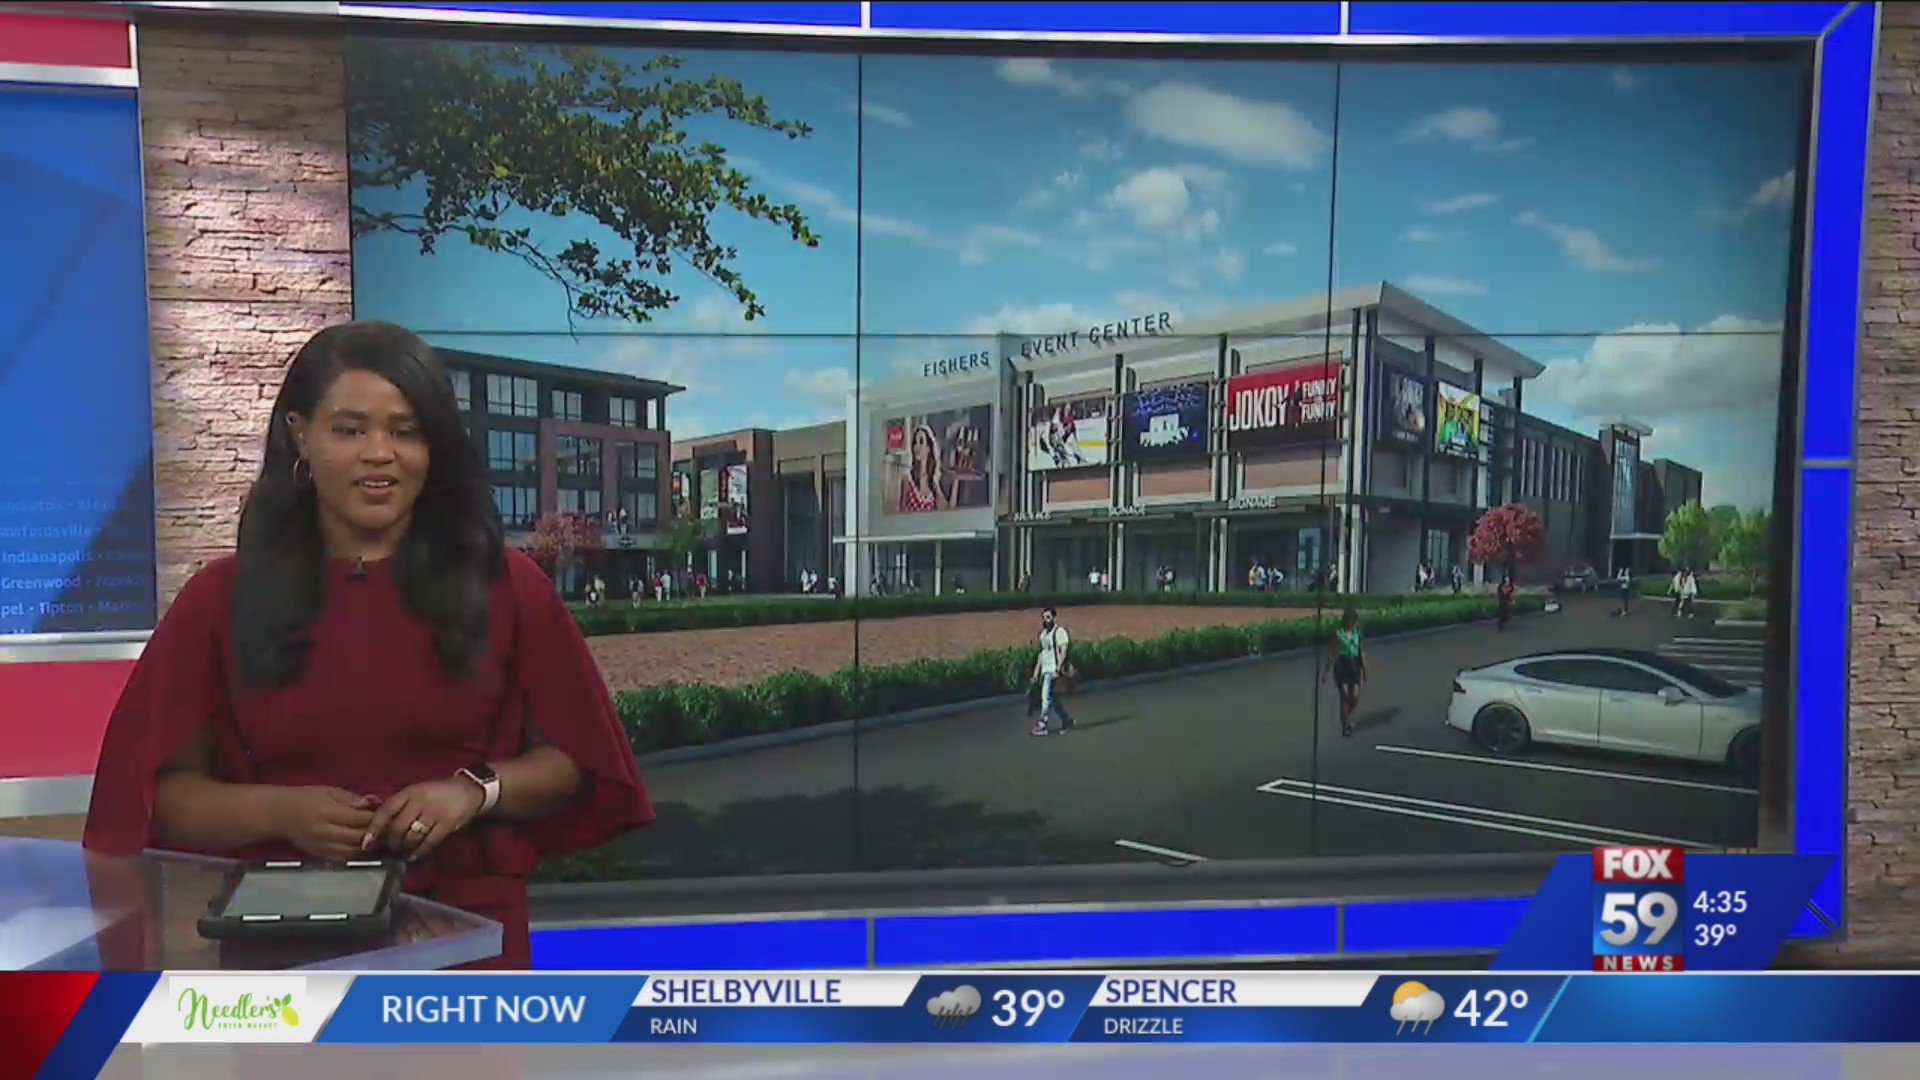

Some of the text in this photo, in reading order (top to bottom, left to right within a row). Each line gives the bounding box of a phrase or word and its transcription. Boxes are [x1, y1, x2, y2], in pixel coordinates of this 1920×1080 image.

[923, 311, 1172, 377] FISHERS EVENT CENTER
[1230, 384, 1289, 432] JOKOY
[2, 550, 93, 566] Indianapolis
[2, 577, 80, 589] Greenwood
[2, 602, 24, 618] pel
[40, 601, 83, 617] Tipton
